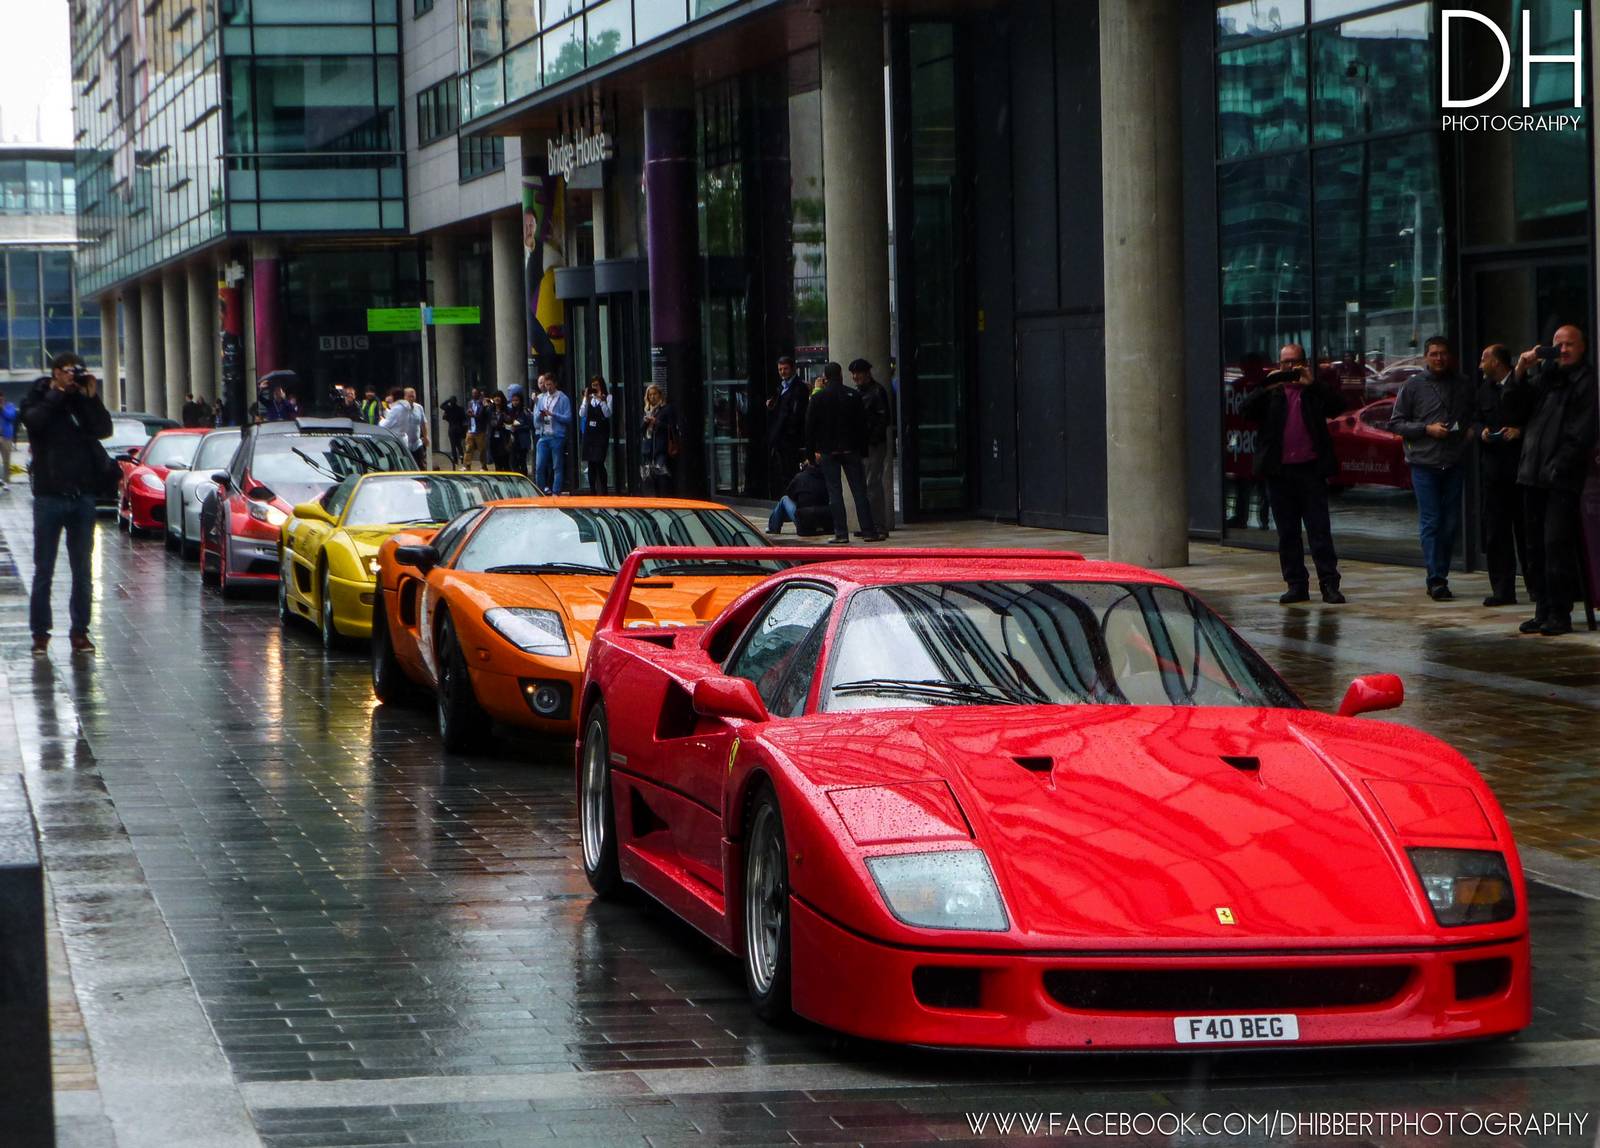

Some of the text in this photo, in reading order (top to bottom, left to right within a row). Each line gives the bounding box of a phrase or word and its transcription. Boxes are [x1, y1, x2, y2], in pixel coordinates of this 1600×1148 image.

[547, 127, 606, 183] Bridge House
[321, 336, 368, 350] BBC
[1226, 430, 1258, 463] spac
[1190, 1017, 1284, 1040] F40 BEG
